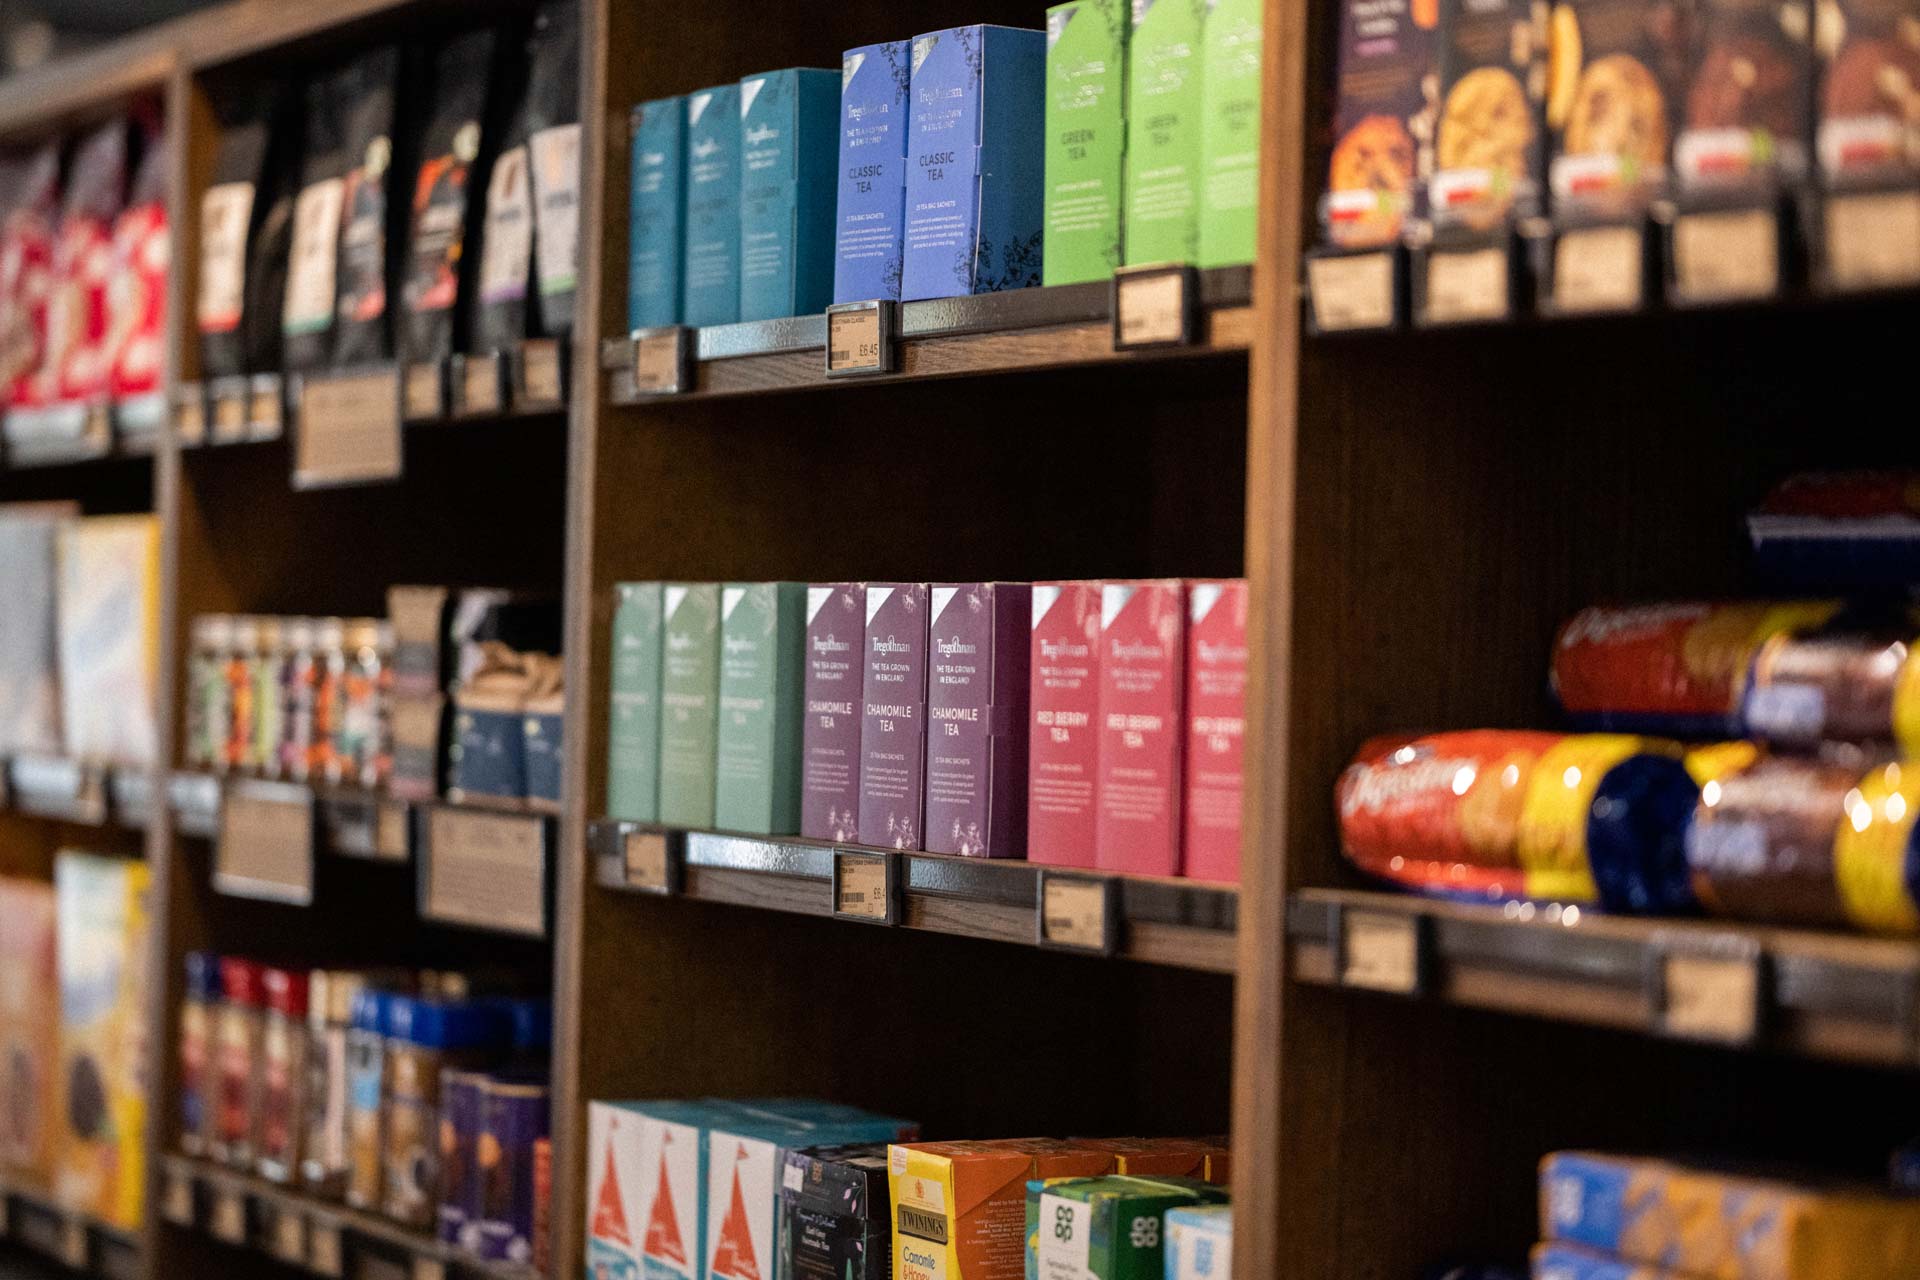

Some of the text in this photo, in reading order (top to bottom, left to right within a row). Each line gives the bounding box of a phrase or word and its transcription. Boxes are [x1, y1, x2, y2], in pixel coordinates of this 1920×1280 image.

[919, 152, 955, 167] CLASSIC
[849, 164, 882, 179] CLASSIC
[928, 168, 944, 181] TEA
[857, 181, 872, 193] TEA
[859, 343, 878, 357] £6.45
[873, 635, 910, 656] Tregothnan
[937, 635, 976, 658] Tregothnan
[872, 662, 910, 673] THE TEA GROWN
[936, 665, 976, 675] THE TEA GROWN
[881, 673, 905, 683] ENGLAND
[946, 676, 971, 685] ENGLAND
[809, 700, 853, 715] CHAMOMILE
[867, 703, 911, 719] CHAMOMILE
[932, 706, 978, 721] CHAMOMILE
[820, 716, 835, 729] TEA
[880, 719, 895, 732] TEA
[944, 722, 960, 736] TEA
[903, 1210, 944, 1236] TWININGS
[903, 1246, 936, 1271] Camomile
